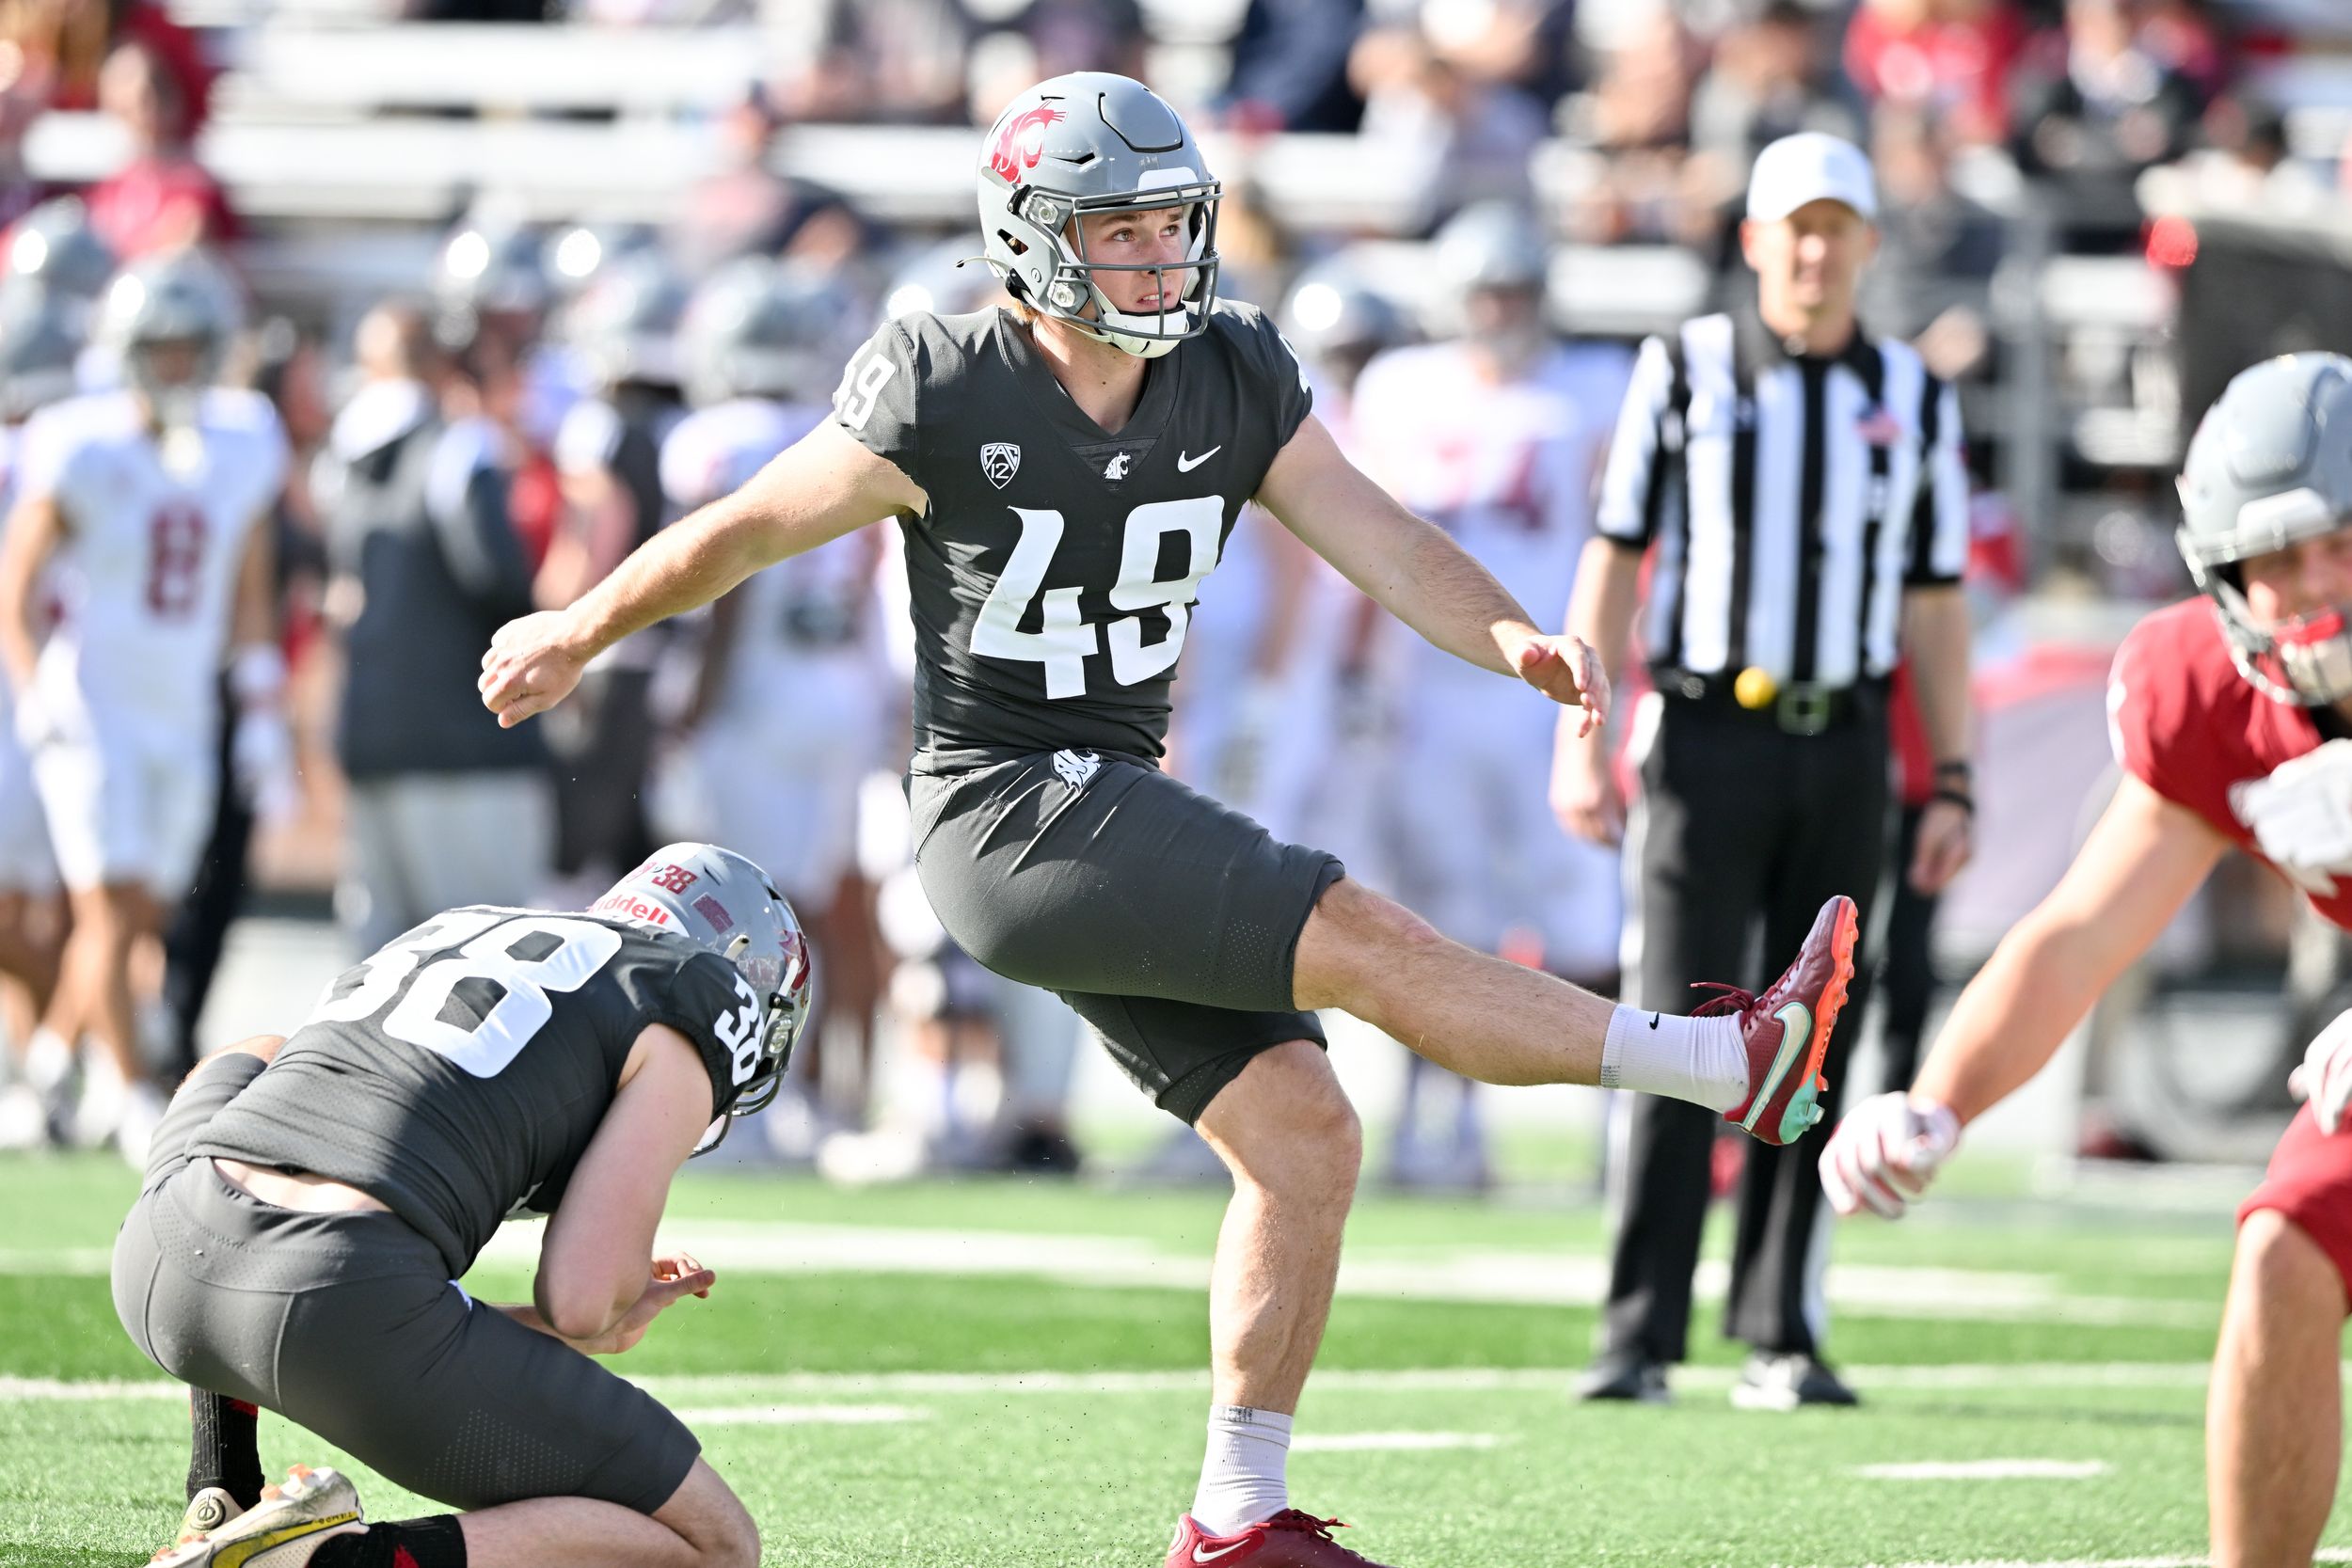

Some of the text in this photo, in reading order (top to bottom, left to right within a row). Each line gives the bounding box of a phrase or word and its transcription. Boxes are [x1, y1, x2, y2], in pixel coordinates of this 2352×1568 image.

[983, 445, 1018, 471] PAC
[991, 462, 1009, 479] 12
[969, 495, 1225, 700] 49
[651, 863, 698, 895] 38
[292, 905, 622, 1078] 38
